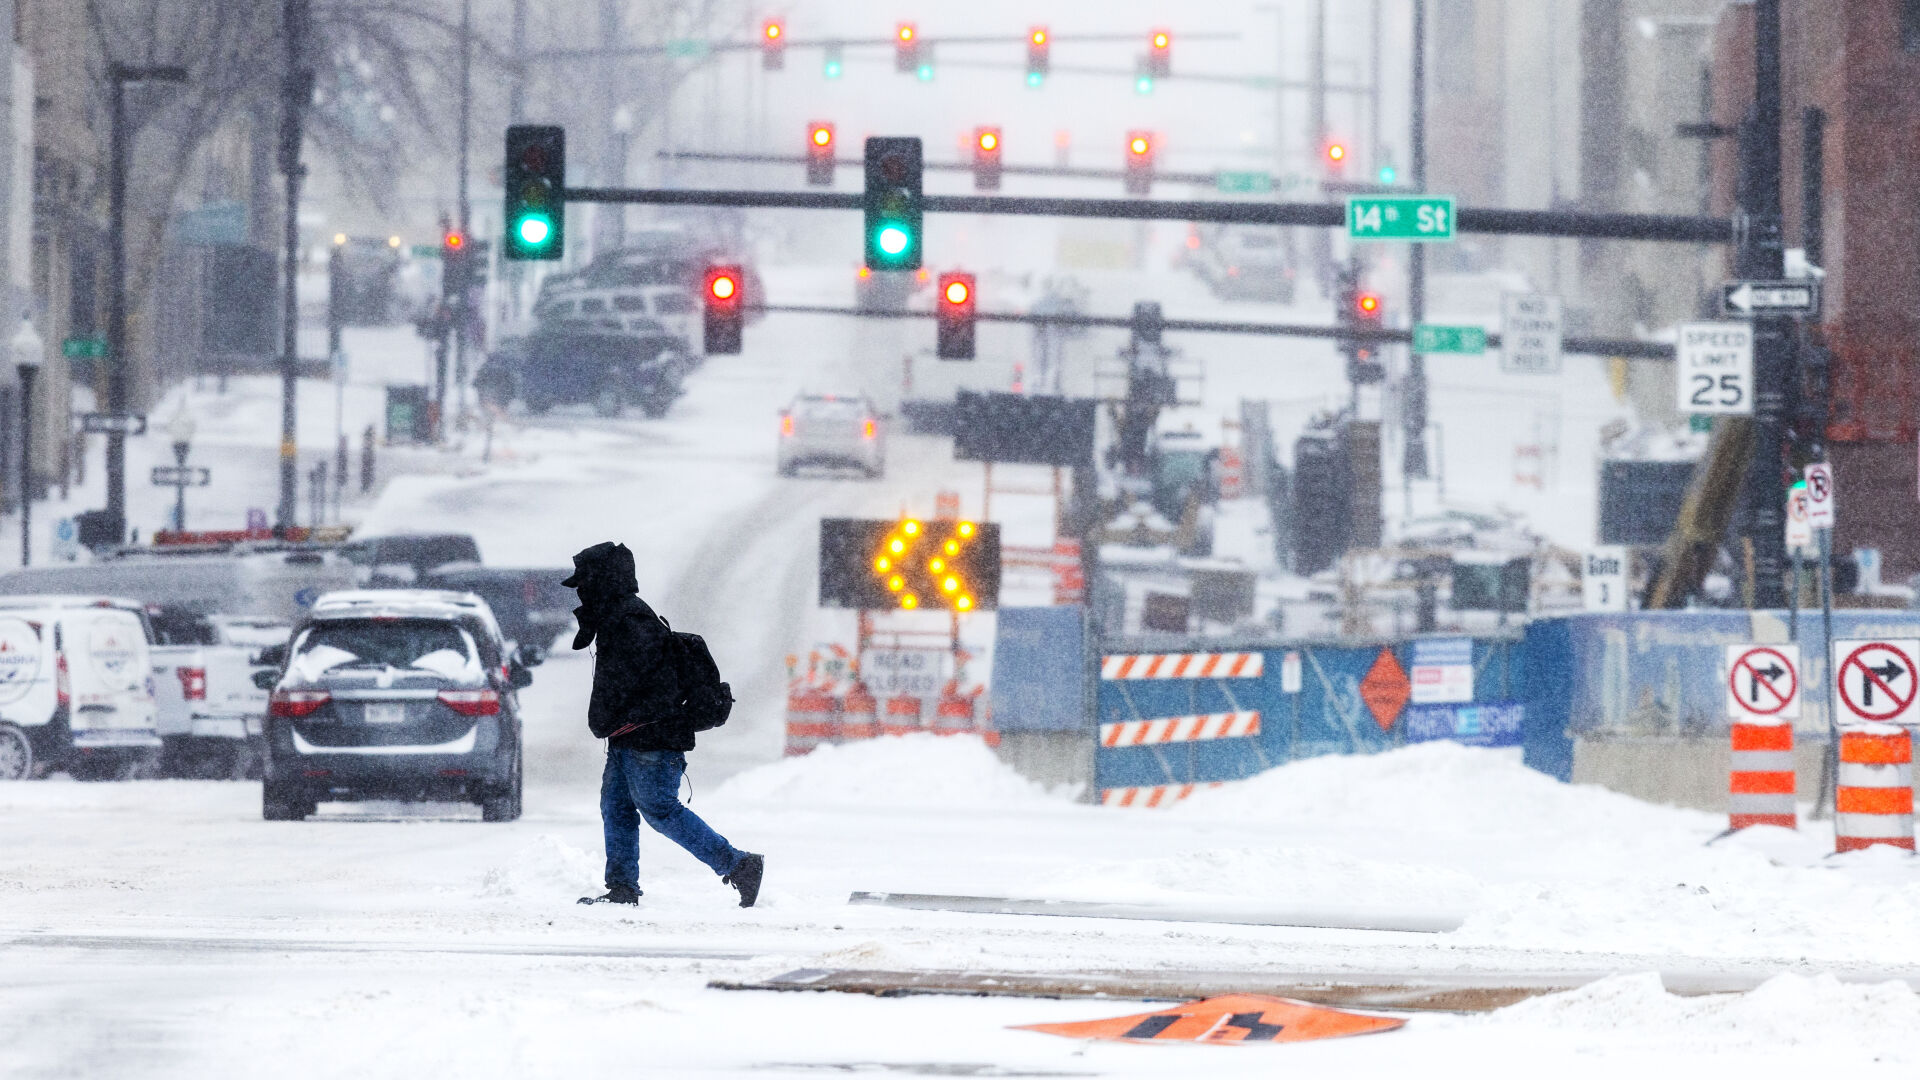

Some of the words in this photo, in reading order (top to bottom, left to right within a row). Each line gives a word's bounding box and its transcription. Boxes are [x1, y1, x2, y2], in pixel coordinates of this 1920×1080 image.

[1353, 204, 1399, 231] 14th
[1416, 204, 1447, 232] St
[1686, 331, 1746, 347] SPEED
[1690, 353, 1738, 368] LIMIT
[1690, 374, 1744, 406] 25
[1588, 554, 1619, 577] Gate
[874, 653, 924, 670] ROAD
[865, 675, 935, 691] CLOSED
